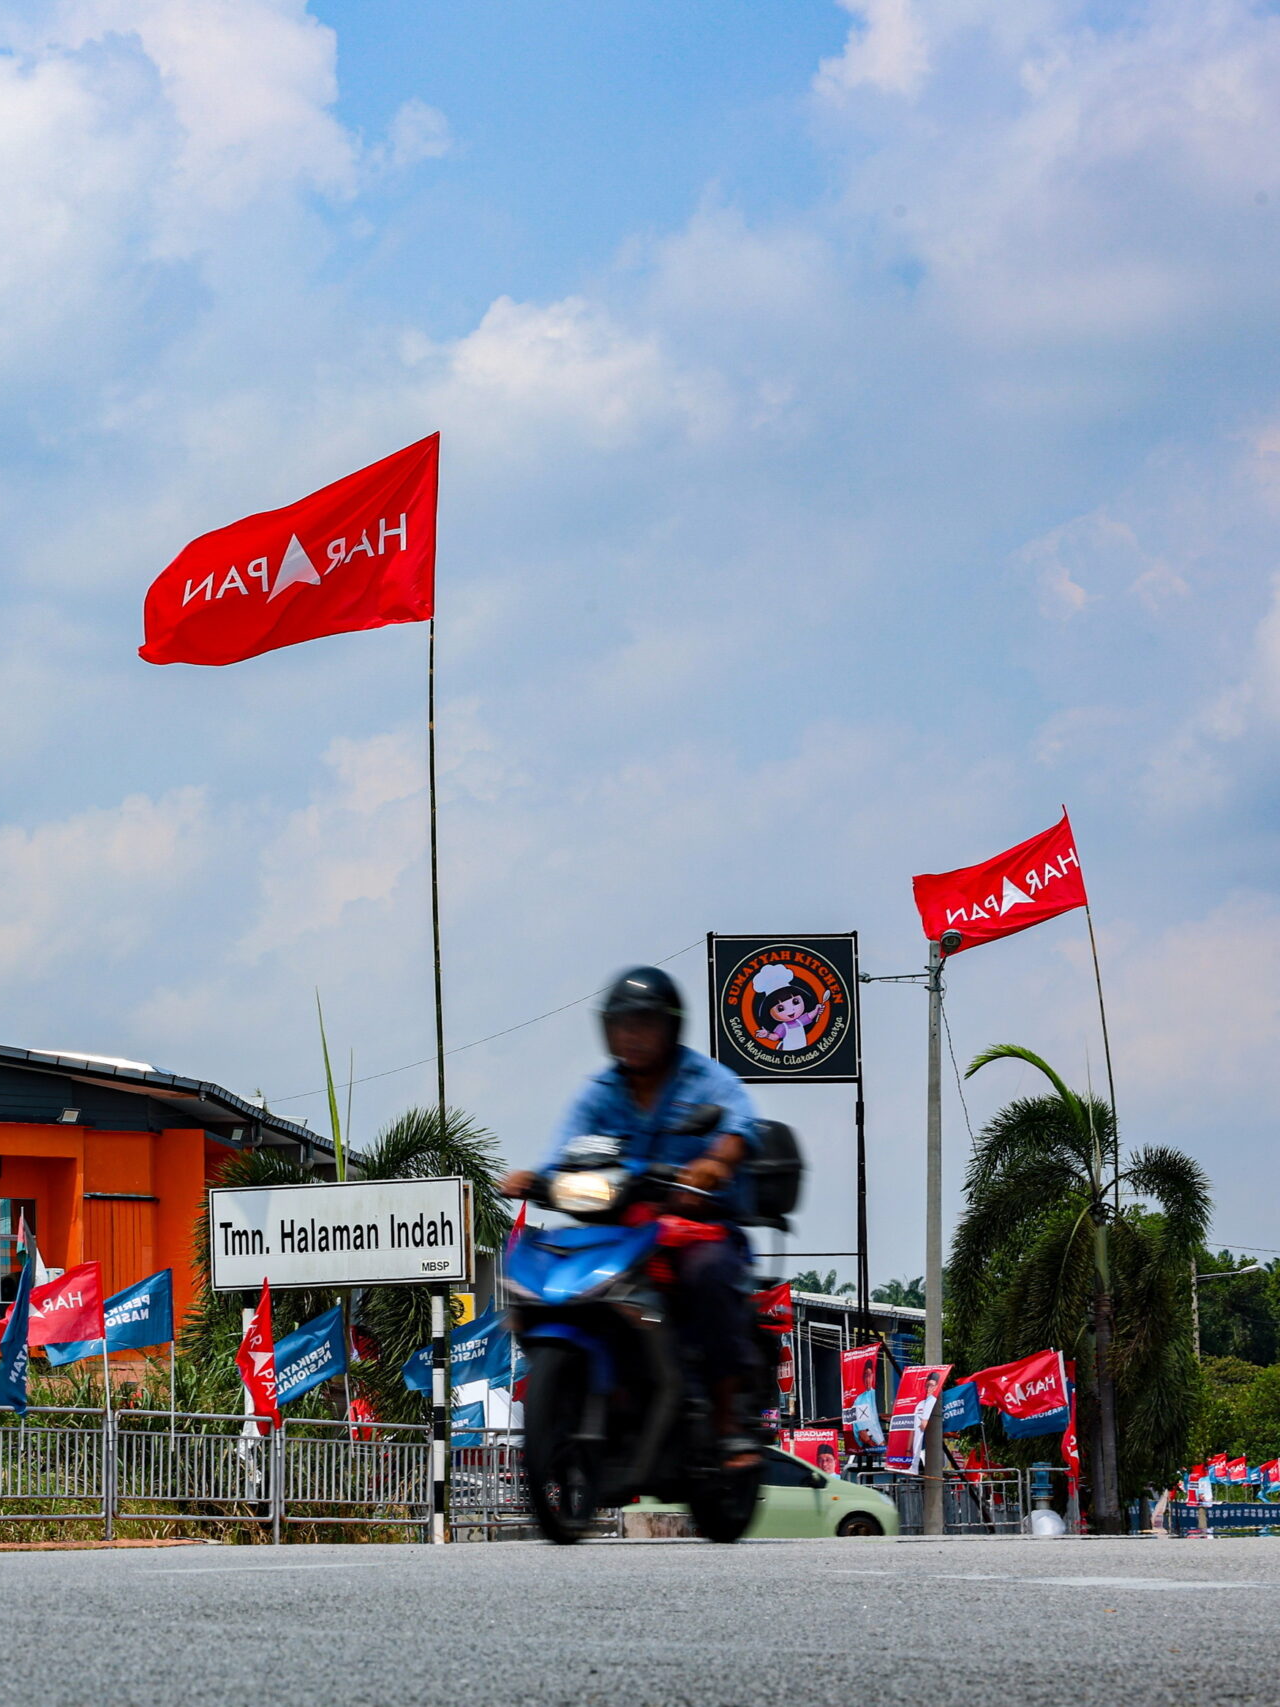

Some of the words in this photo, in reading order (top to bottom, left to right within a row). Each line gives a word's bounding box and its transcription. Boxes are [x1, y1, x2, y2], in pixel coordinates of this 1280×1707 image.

[727, 950, 791, 1006] SUMAYYAH
[794, 951, 844, 1004] KITCHEN
[729, 1016, 745, 1043] Selera
[744, 1041, 781, 1065] Menjamin
[783, 1050, 820, 1065] Citarasa
[817, 1016, 843, 1053] Keluarga
[219, 1222, 270, 1256] Tmn.
[280, 1218, 380, 1254] Halaman
[390, 1211, 454, 1249] Indah
[421, 1261, 450, 1272] MBSP
